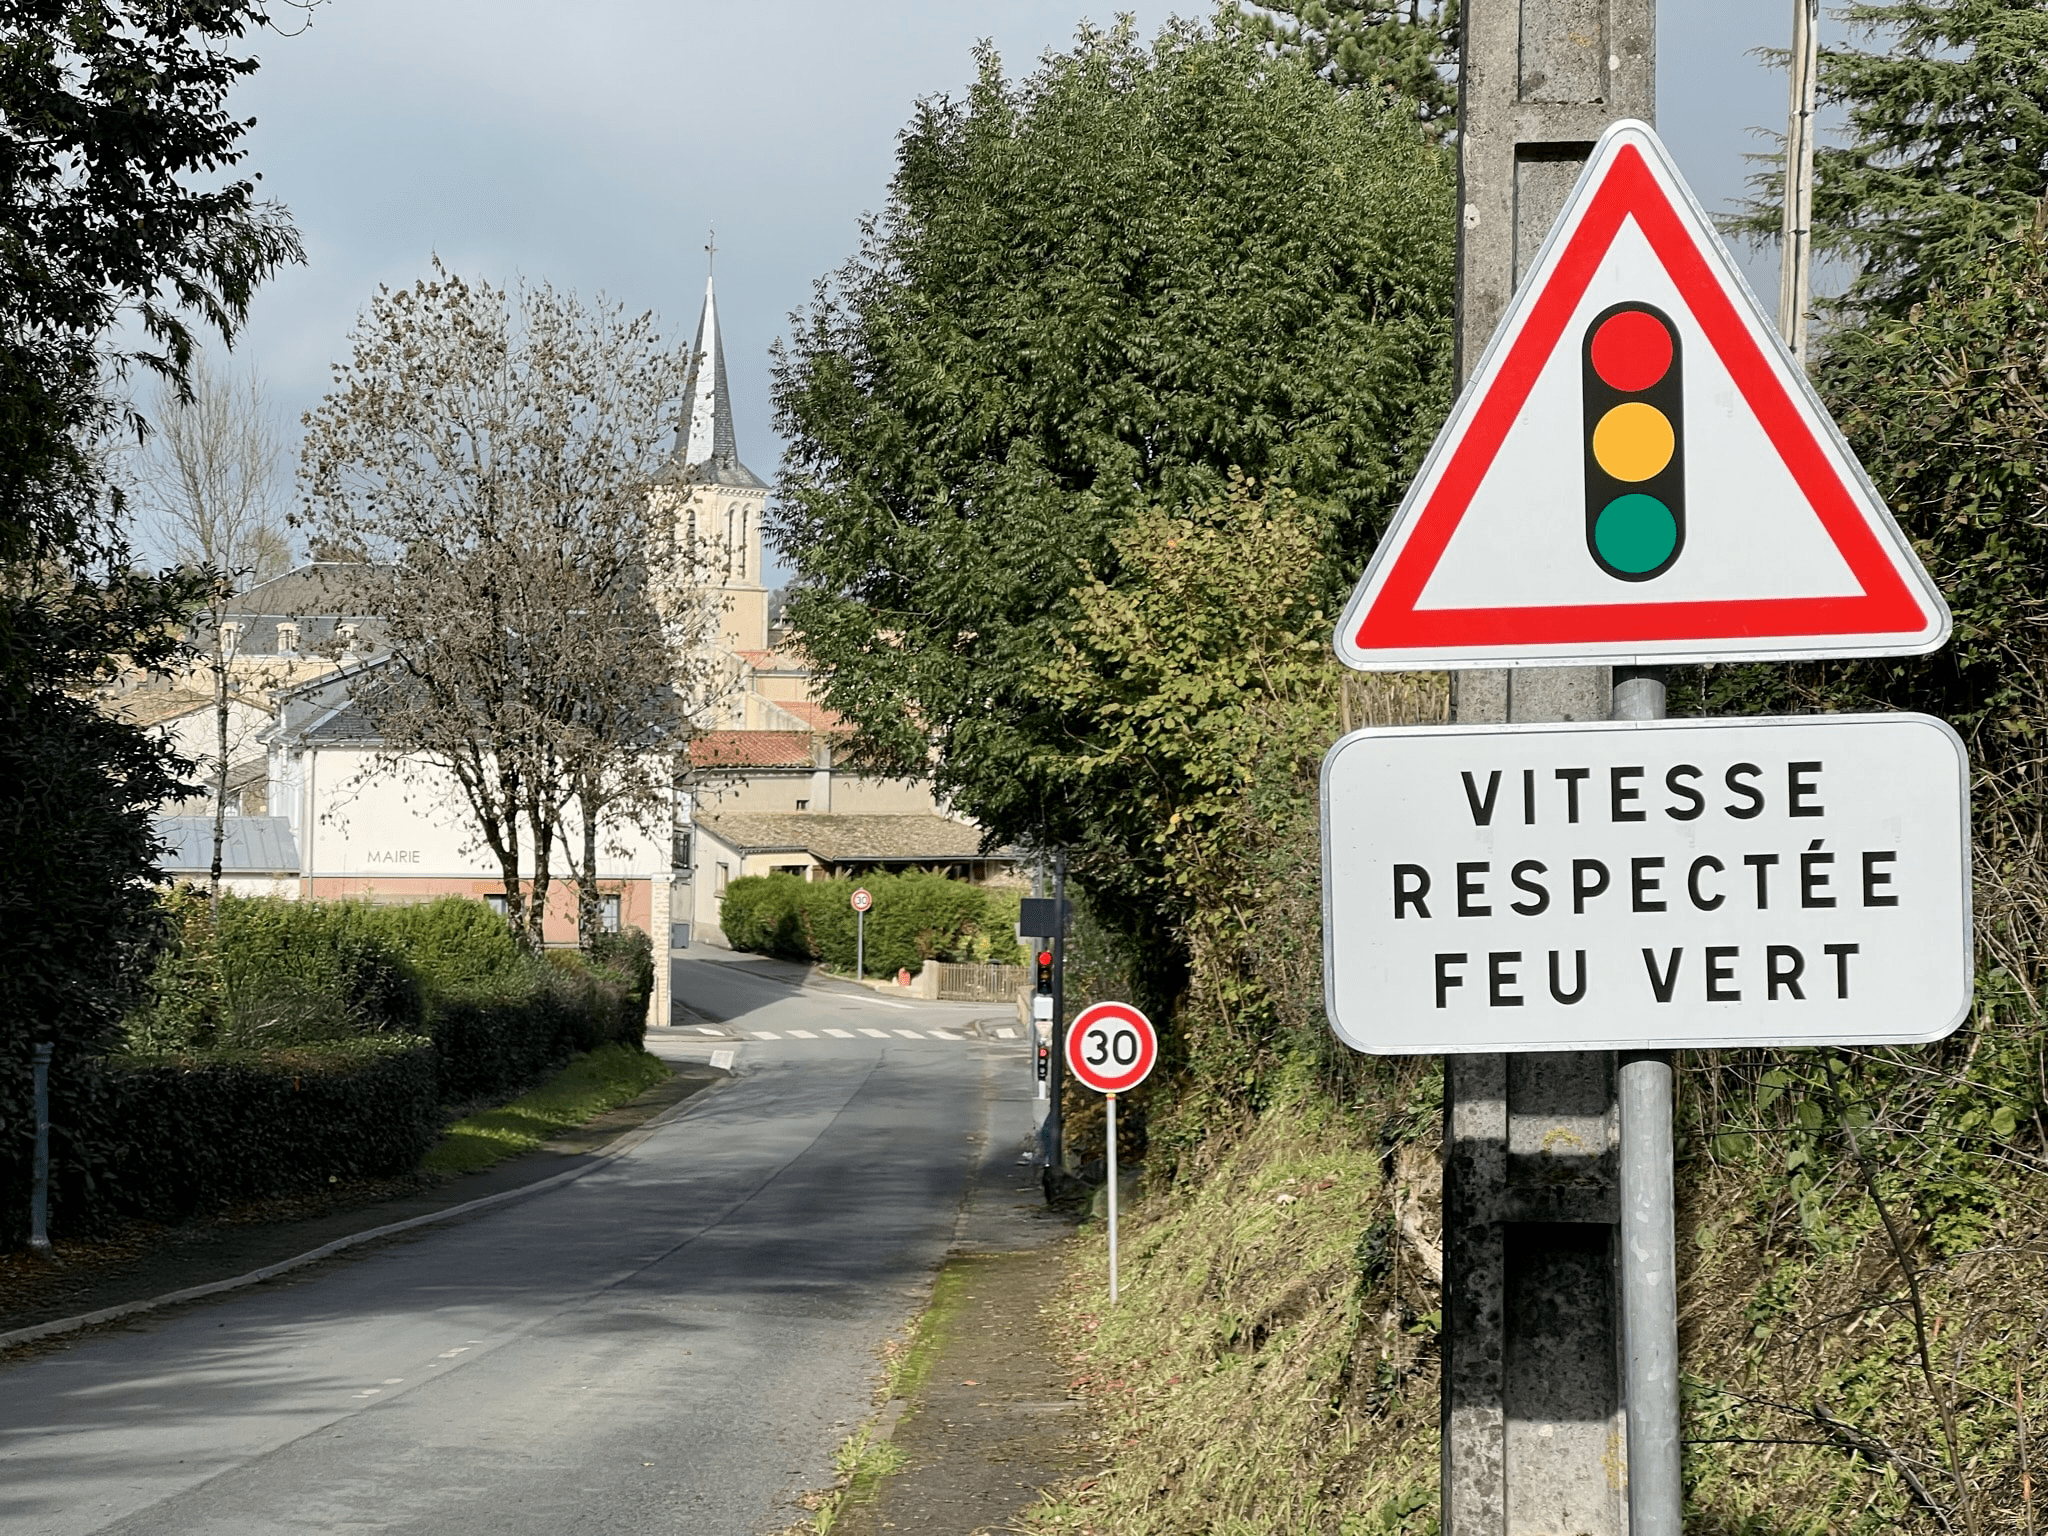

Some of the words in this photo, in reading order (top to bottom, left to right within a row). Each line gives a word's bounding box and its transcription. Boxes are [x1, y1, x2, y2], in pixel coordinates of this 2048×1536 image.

[1460, 761, 1825, 827] VITESSE
[367, 850, 421, 863] MAIRIE
[1393, 838, 1899, 920] RESPECTÉE
[1434, 949, 1587, 1009] FEU
[1641, 943, 1860, 1003] VERT
[1086, 1029, 1138, 1066] 30
